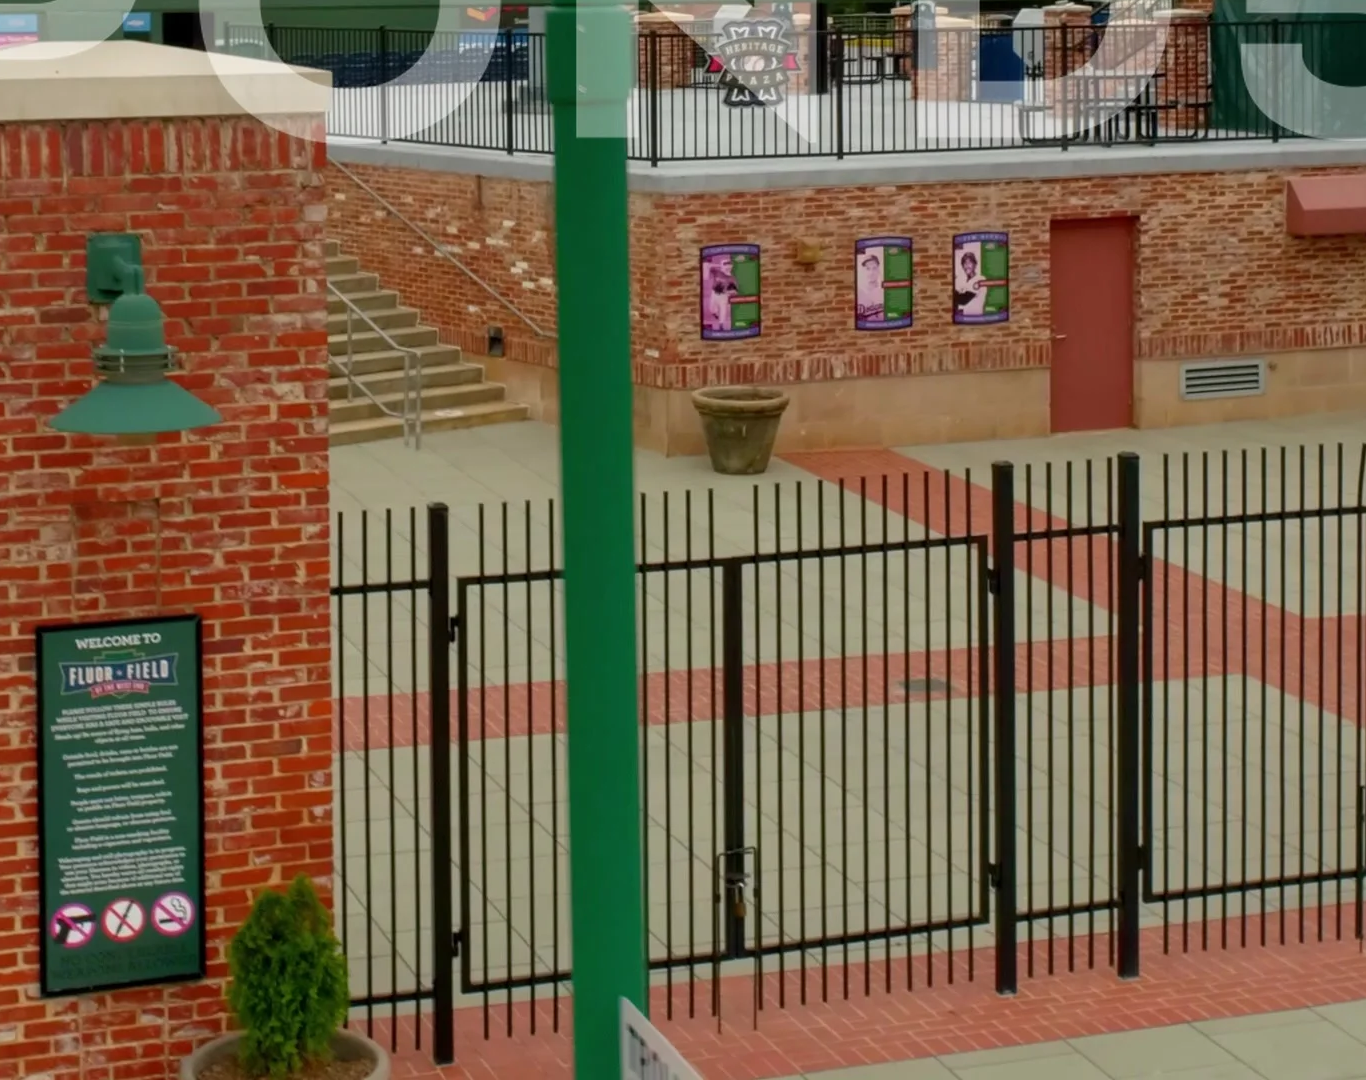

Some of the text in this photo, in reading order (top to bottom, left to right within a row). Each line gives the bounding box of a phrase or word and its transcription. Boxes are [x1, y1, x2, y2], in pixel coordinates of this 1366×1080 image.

[725, 41, 784, 55] HERITAGE
[726, 71, 783, 85] PLAZA
[75, 632, 162, 649] WELCOME TO
[68, 659, 170, 687] FLUOR FIELD
